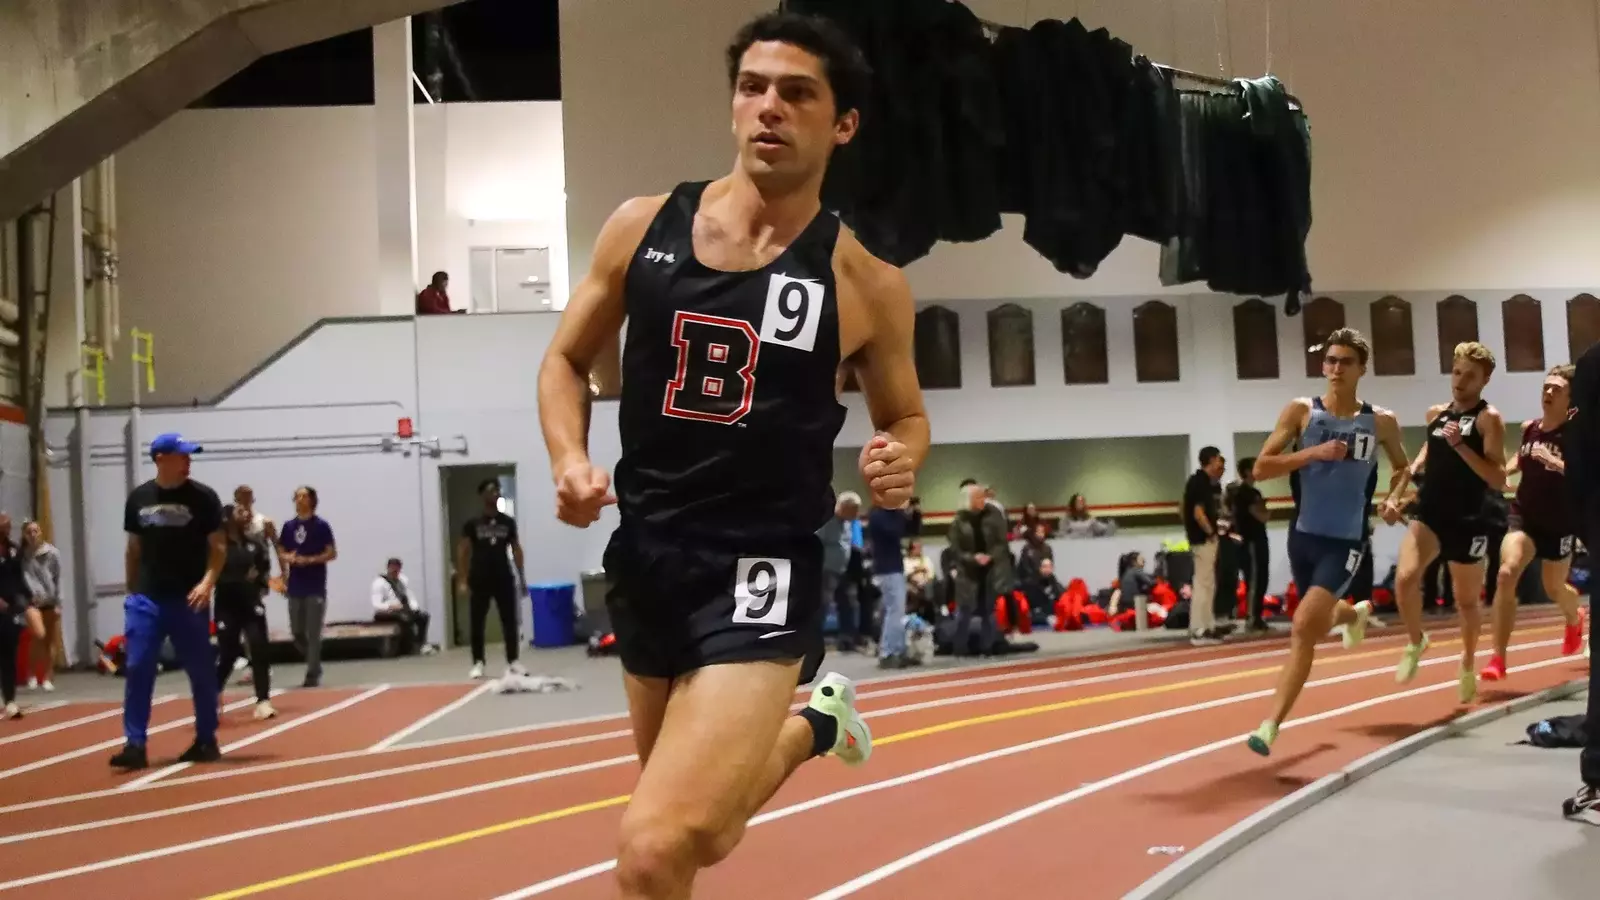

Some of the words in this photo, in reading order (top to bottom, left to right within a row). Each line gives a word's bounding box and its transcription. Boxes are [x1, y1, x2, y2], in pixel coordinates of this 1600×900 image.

[774, 281, 809, 341] 9
[662, 310, 760, 425] B
[1359, 436, 1369, 458] 1
[1473, 539, 1485, 555] 7
[745, 561, 777, 619] 9
